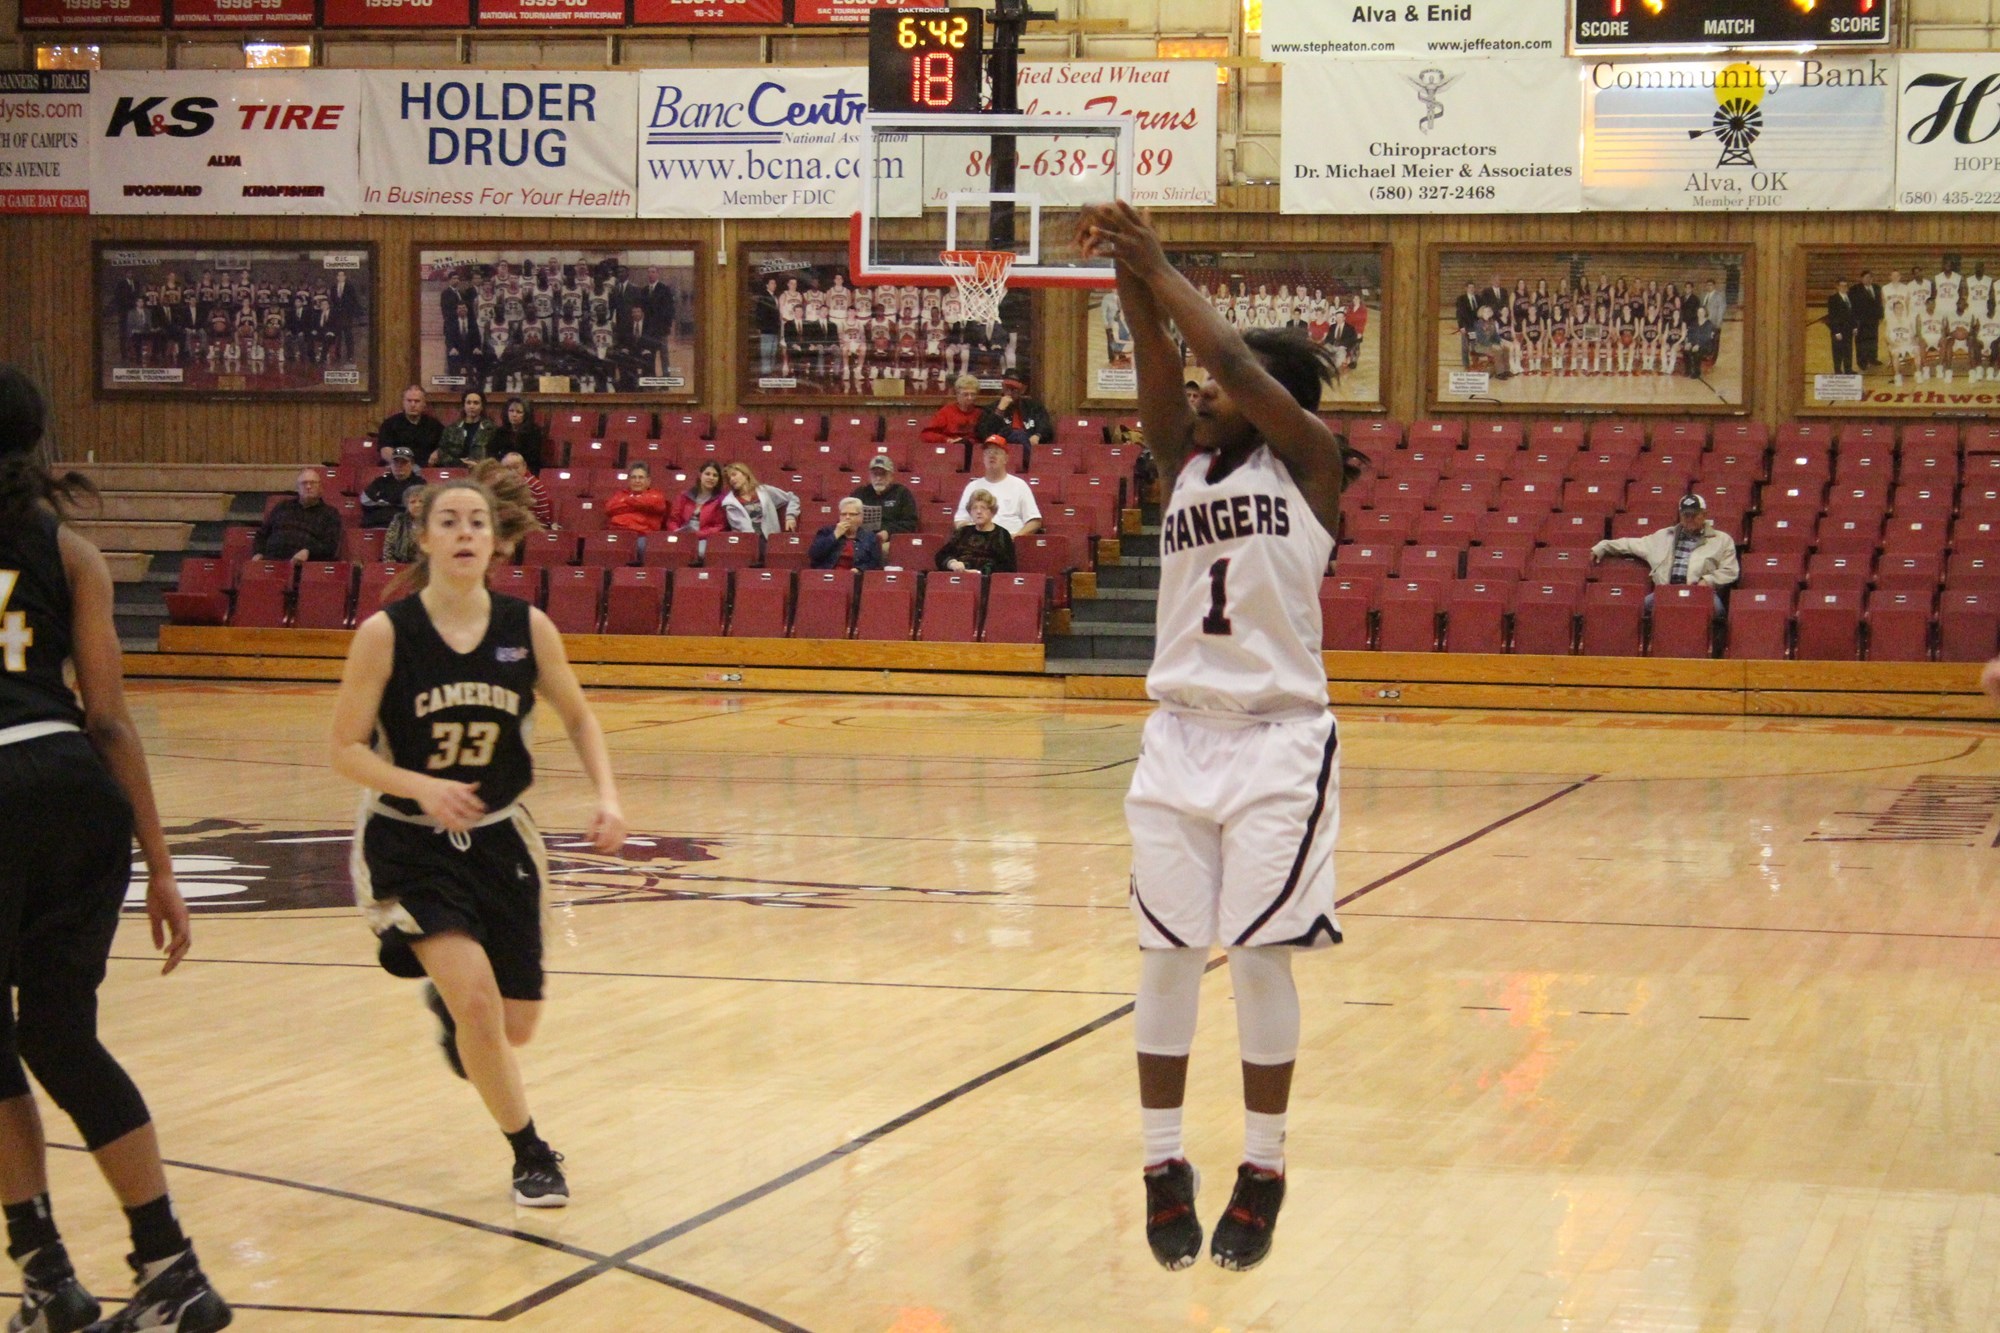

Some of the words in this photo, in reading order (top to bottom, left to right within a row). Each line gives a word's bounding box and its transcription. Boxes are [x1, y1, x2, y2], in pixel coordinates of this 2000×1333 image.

[216, 0, 281, 9] 1998-99
[23, 16, 60, 24] NATIONAL
[62, 15, 112, 24] TOURNAMENT
[113, 15, 160, 23] PARTICIPANT
[174, 14, 211, 22] NATIONAL
[213, 14, 263, 22] TOURNAMENT
[265, 13, 313, 21] PARTICIPANT
[480, 12, 517, 20] NATIONAL
[520, 12, 572, 20] TOURNAMENT
[574, 12, 622, 20] PARTICIPANT
[1352, 6, 1396, 23] Alva
[1404, 5, 1419, 21] &
[1427, 5, 1472, 21] Enid
[898, 17, 968, 48] 6:42
[1581, 21, 1629, 37] SCORE
[1704, 19, 1755, 34] MATCH
[1830, 17, 1880, 33] SCORE
[1271, 41, 1395, 54] www.stepheaton.com
[1427, 38, 1552, 53] www.jeffeaton.com
[51, 74, 88, 89] DECALS
[914, 53, 954, 106] 18
[1057, 66, 1101, 83] Seed
[1110, 66, 1170, 83] Wheat
[1592, 60, 1788, 95] Community
[1799, 59, 1888, 88] Bank
[401, 82, 596, 122] HOLDER
[106, 97, 218, 137] K&S
[239, 105, 344, 130] TIRE
[14, 133, 29, 148] OF
[31, 133, 78, 148] CAMPUS
[782, 132, 836, 145] National
[428, 127, 566, 167] DRUG
[1369, 142, 1497, 159] Chiropractors
[15, 162, 60, 177] AVENUE
[208, 156, 241, 167] ALVA
[1294, 165, 1320, 179] Dr.
[1326, 164, 1396, 178] Michael
[1402, 164, 1454, 178] Meier
[1459, 164, 1473, 178] &
[1478, 163, 1573, 178] Associates
[1684, 172, 1742, 193] Alva,
[1751, 172, 1788, 191] OK
[124, 185, 202, 197] WOODWARD
[243, 185, 325, 197] KINGFISHER
[364, 186, 381, 203] In
[388, 186, 473, 205] Business
[480, 188, 512, 205] For
[521, 188, 563, 206] Your
[568, 189, 630, 207] Health
[723, 190, 787, 206] Member
[793, 190, 835, 205] FDIC
[1162, 187, 1210, 202] Shirley
[1369, 185, 1413, 201] (580)
[1419, 185, 1496, 200] 327-2468
[1900, 191, 1937, 206] (580)
[9, 194, 36, 207] GAME
[38, 194, 58, 207] DAY
[60, 194, 87, 207] GEAR
[1692, 195, 1743, 207] Member
[1748, 195, 1782, 207] FDIC
[1165, 494, 1290, 556] RANGERS
[1203, 558, 1232, 635] 1
[415, 681, 521, 718] CAMERON
[427, 722, 500, 770] 33
